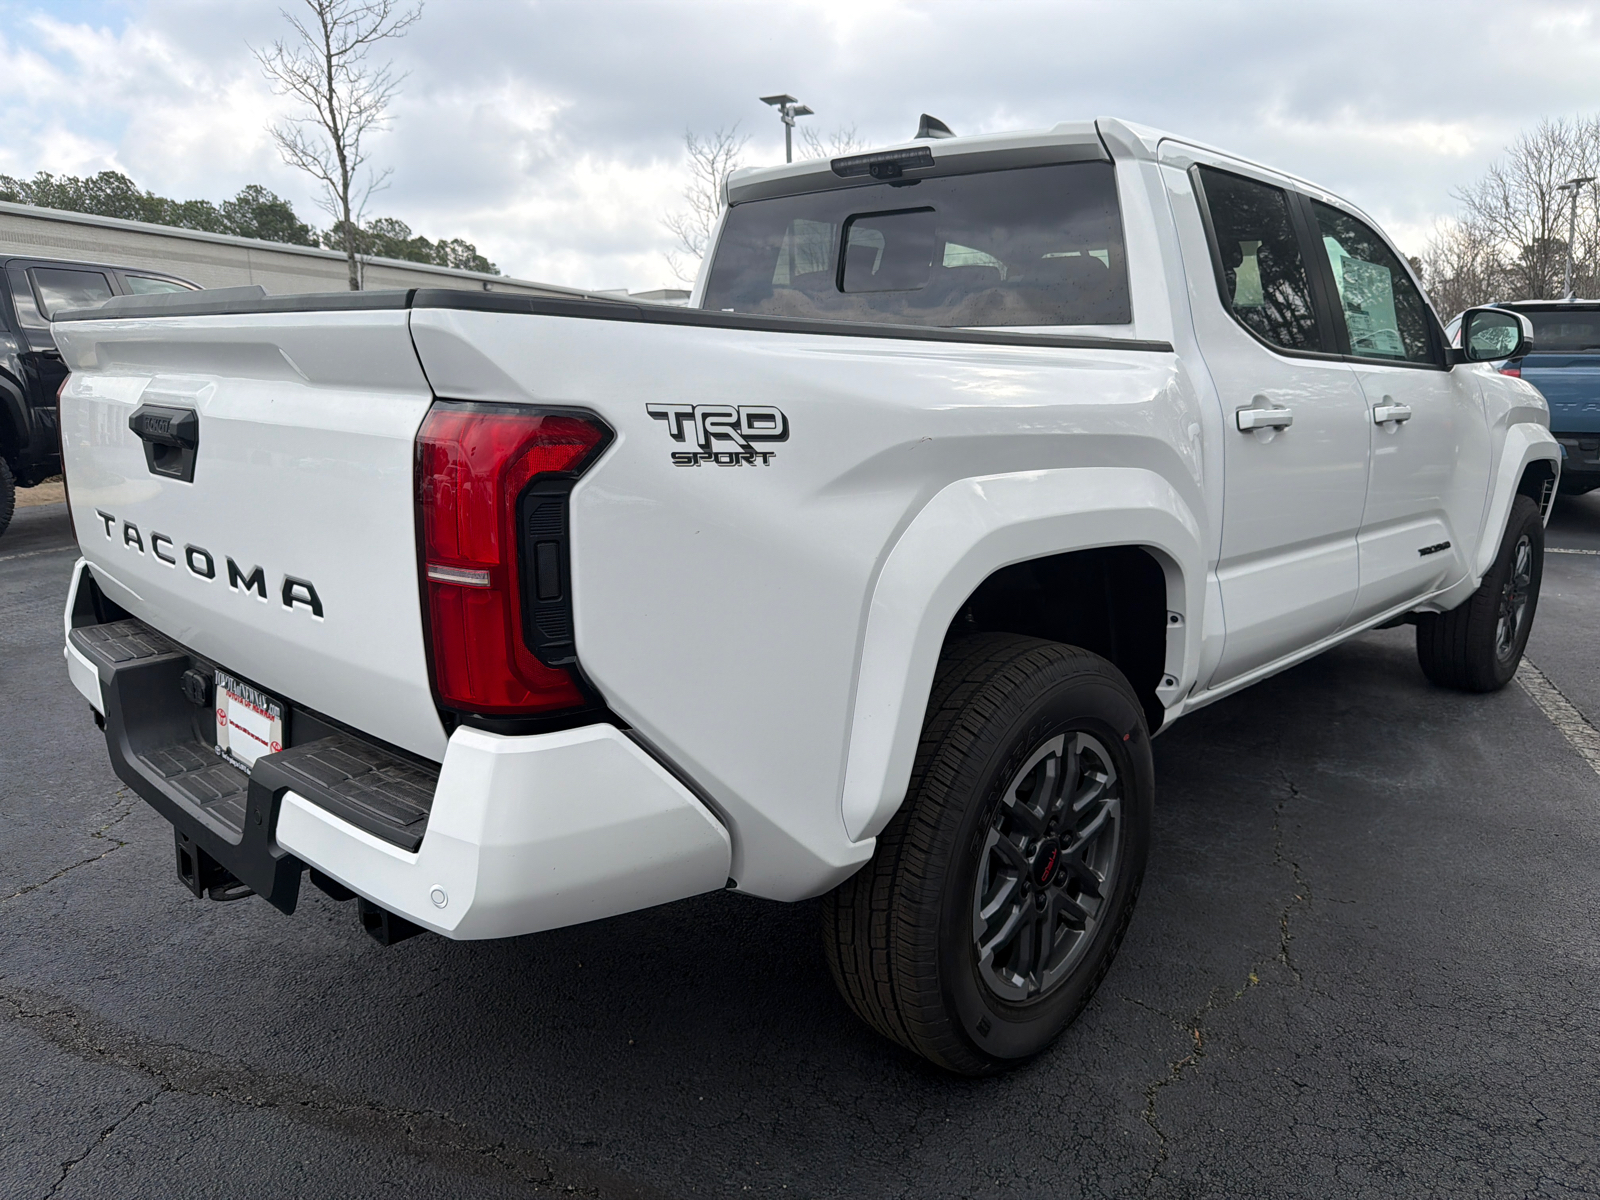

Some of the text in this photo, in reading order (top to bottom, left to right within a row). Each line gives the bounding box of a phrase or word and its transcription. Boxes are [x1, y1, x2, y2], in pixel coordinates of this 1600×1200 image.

[645, 403, 790, 453] TRD
[670, 451, 776, 467] SPORT
[94, 508, 324, 620] TACOMA
[1041, 847, 1058, 882] TRD
